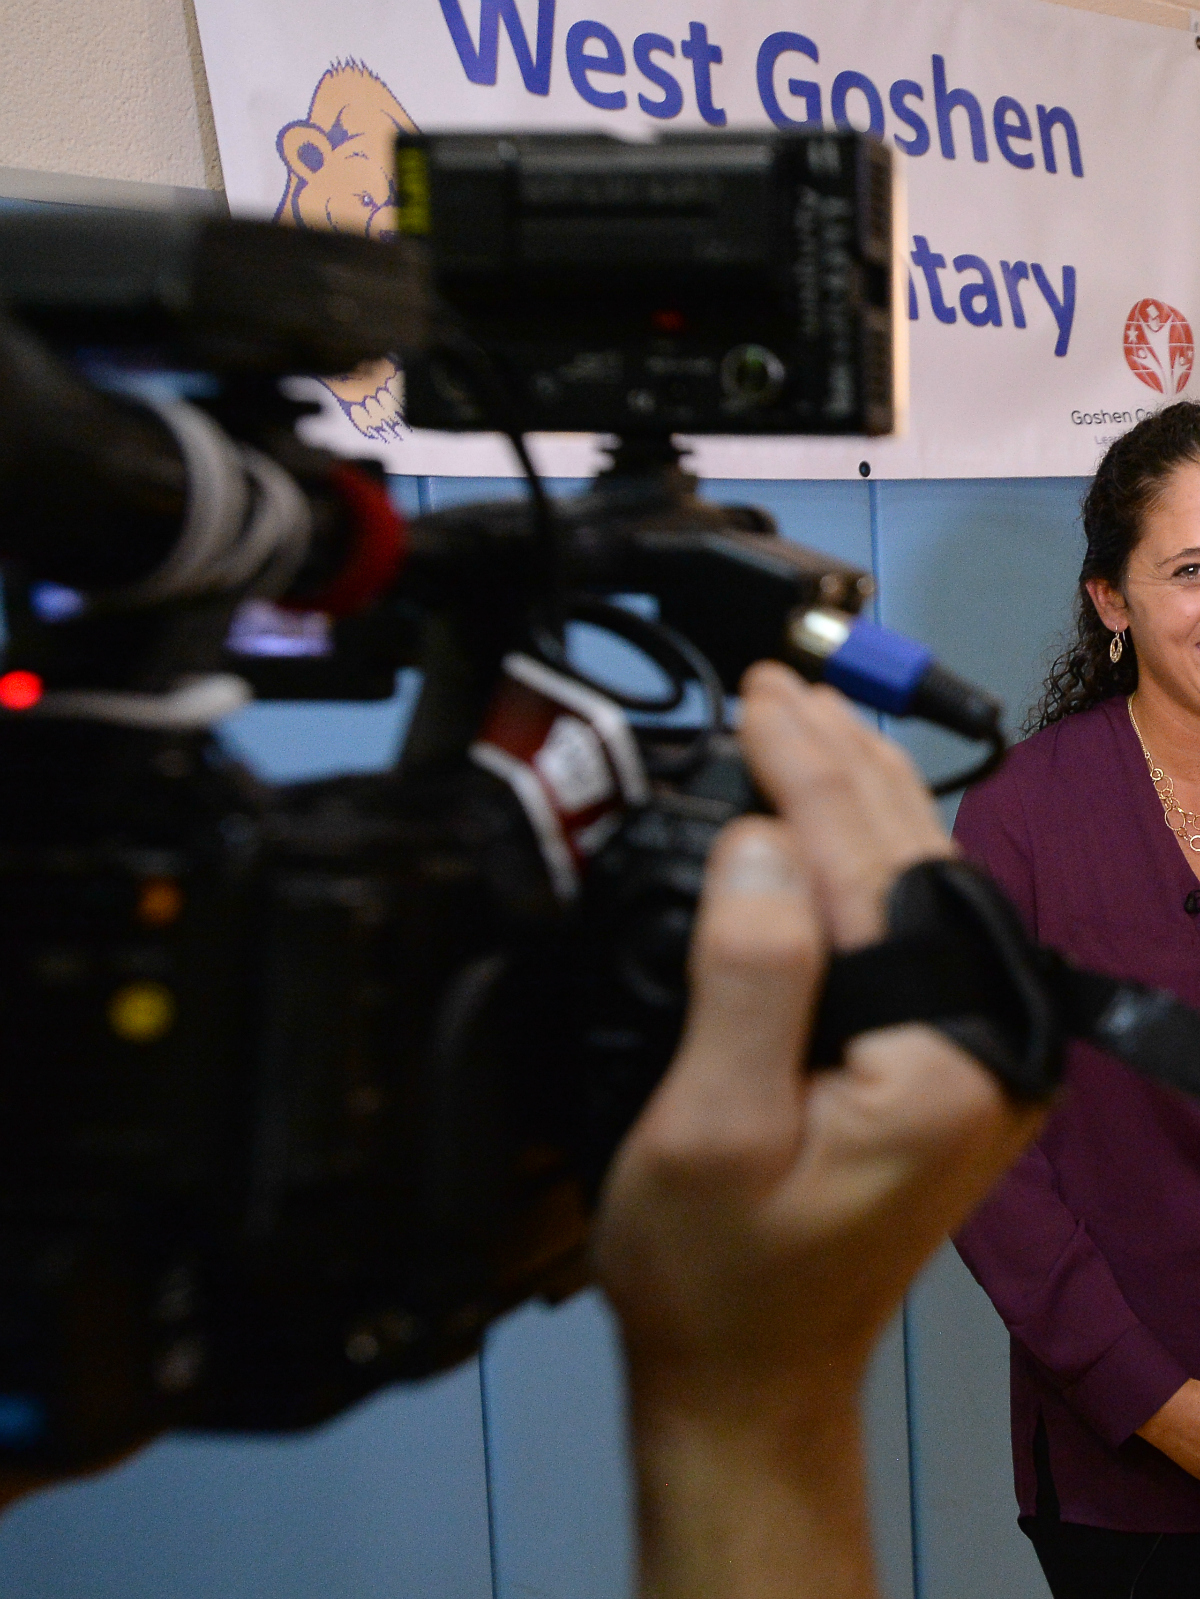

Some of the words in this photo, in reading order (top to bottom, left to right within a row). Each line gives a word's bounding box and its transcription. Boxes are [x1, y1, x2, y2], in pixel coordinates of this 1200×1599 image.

[437, 0, 727, 127] West
[755, 30, 1084, 178] Goshen
[908, 234, 1076, 357] tary
[1071, 409, 1132, 425] Goshen
